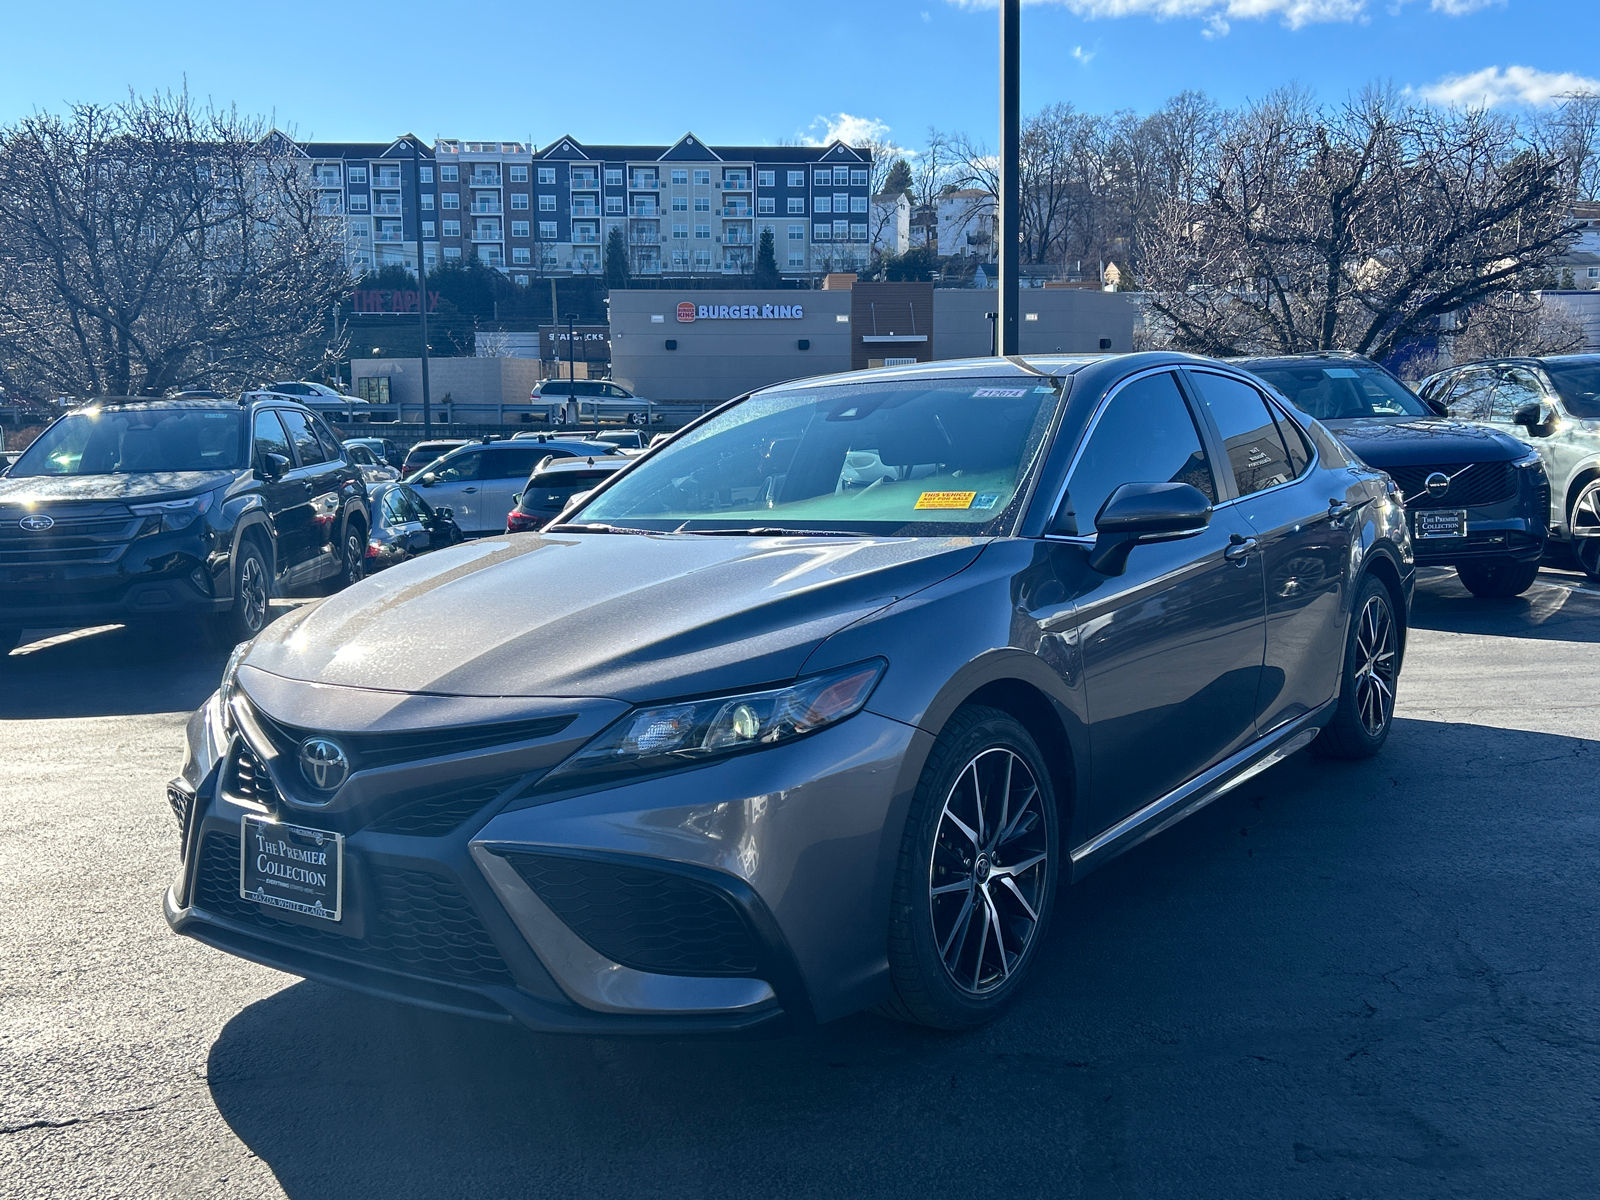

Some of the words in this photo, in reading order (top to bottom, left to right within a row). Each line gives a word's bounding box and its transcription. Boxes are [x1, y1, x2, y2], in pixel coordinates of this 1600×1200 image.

[354, 290, 386, 312] THE
[392, 290, 440, 312] APX
[699, 305, 759, 319] BURGER
[762, 304, 803, 319] KING
[256, 834, 279, 856] THE
[278, 840, 327, 866] PREMIER
[257, 854, 326, 887] COLLECTION
[252, 893, 276, 905] MAZDA
[277, 900, 300, 911] WHITE
[302, 905, 328, 917] PLAINS
